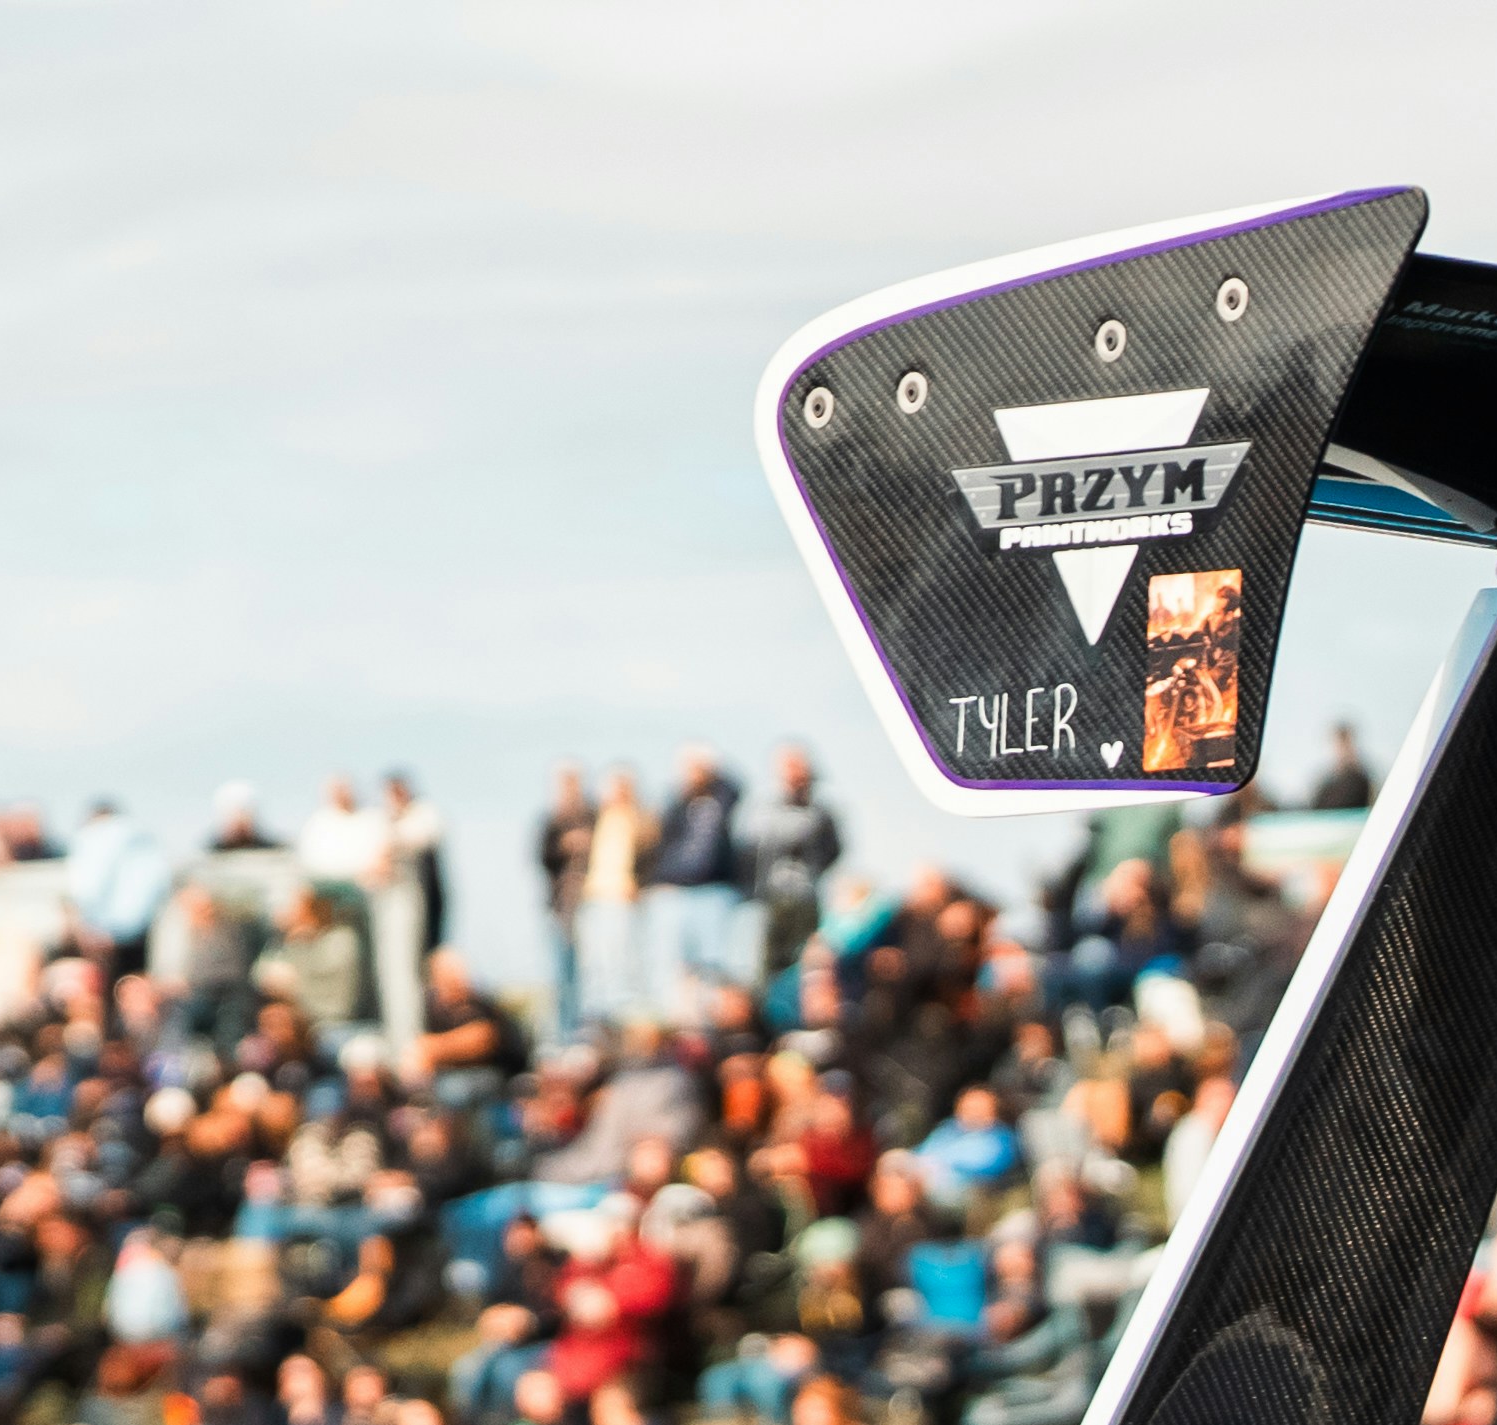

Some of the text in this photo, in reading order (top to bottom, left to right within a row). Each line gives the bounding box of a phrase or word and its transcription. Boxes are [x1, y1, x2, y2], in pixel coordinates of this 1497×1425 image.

[988, 457, 1208, 521] PRZYM
[999, 511, 1194, 550] PAINTWORKS
[948, 682, 1079, 760] TYLER
